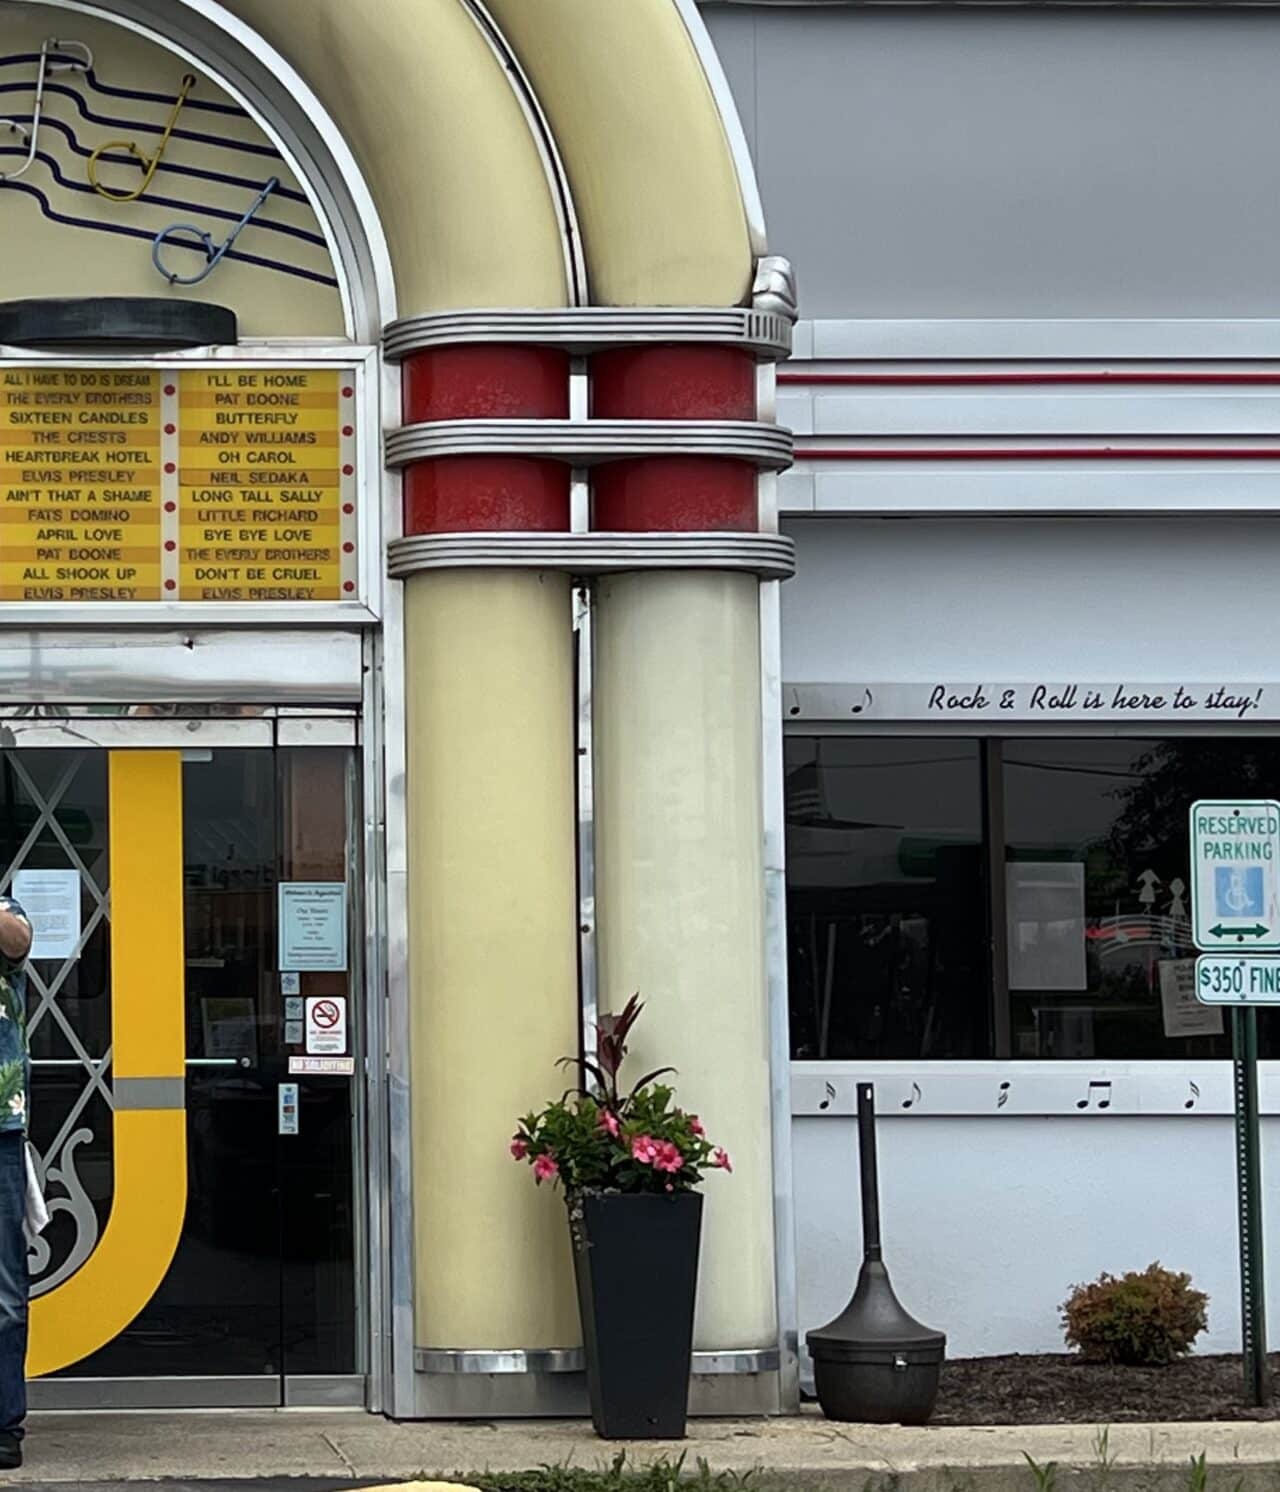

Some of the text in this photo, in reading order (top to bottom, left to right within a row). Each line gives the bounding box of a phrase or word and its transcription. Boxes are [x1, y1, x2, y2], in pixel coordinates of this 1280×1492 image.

[4, 374, 150, 386] ALL I HAVE TO DO IS DREAM
[207, 375, 307, 387] I'LL BE HOME
[8, 392, 28, 405] THE
[215, 393, 299, 406] PAT BOONE
[10, 412, 148, 424] SIXTEEN CANDLES
[216, 412, 298, 425] BUTTERFLY
[32, 431, 127, 444] THE CRESTS
[200, 432, 316, 445] ANDY WILLIAMS
[6, 451, 152, 464] HEARTBREAK HOTEL
[218, 451, 296, 464] OH CAROL
[22, 470, 135, 483] ELVIS PRESLEY
[210, 471, 309, 484] NEIL SEDAKA
[6, 489, 152, 502] AIN'T THAT A SHAME
[192, 490, 323, 503] LONG TALL SALLY
[28, 509, 130, 522] FATS DOMINO
[198, 510, 318, 523] LITTLE RICHARD
[36, 529, 122, 541] APRIL LOVE
[204, 529, 312, 541] BYE BYE LOVE
[36, 548, 121, 560] PAT BOONE
[186, 548, 210, 560] THE
[23, 568, 136, 580] ALL SHOOK UP
[195, 568, 321, 580] DON'T BE CRUEL
[24, 587, 136, 599] ELVIS PRESLEY
[202, 587, 314, 599] ELVIS PRESLEY
[928, 684, 1263, 718] Rock & Roll is here to stay!
[1198, 816, 1277, 835] RESERVED
[1203, 842, 1273, 860] PARKING
[1200, 966, 1243, 993] $350
